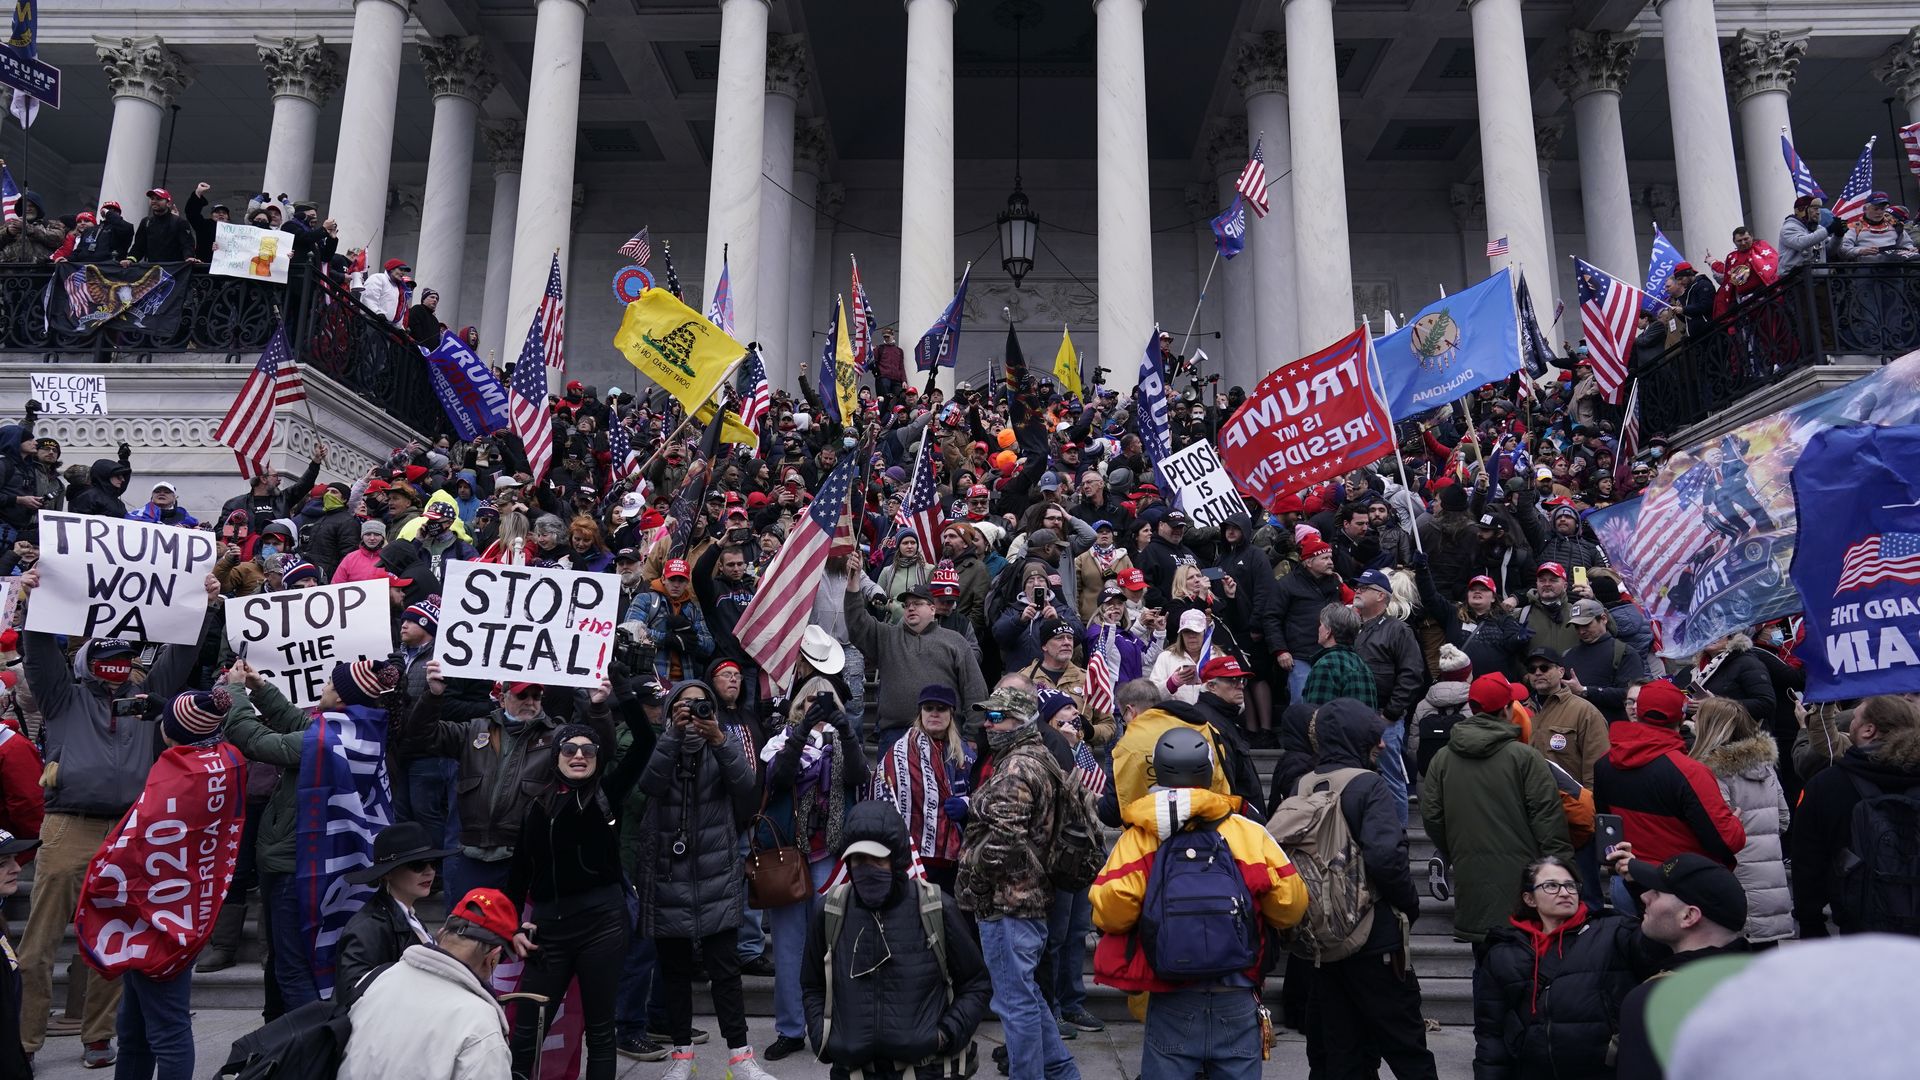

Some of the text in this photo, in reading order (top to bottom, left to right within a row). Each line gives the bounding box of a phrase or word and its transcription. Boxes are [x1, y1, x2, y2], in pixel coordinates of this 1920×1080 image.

[0, 54, 56, 85] TRUMP
[4, 64, 51, 90] PENCE
[31, 375, 106, 392] WELCOME
[37, 390, 99, 403] TO THE
[441, 336, 510, 419] TRUMP
[431, 364, 478, 436] ORE BULLSHIT
[1163, 444, 1220, 490] PELOSI
[1192, 488, 1247, 529] SATAN
[1196, 480, 1213, 499] IS
[43, 514, 213, 574] TRUMP
[87, 563, 177, 607] WON
[460, 568, 604, 629] STOP
[83, 603, 148, 641] PA
[242, 586, 367, 642] STOP
[579, 617, 613, 637] the
[277, 635, 335, 666] THE
[442, 620, 606, 679] STEAL!
[926, 798, 938, 822] But
[197, 750, 227, 938] AMERICA GREA
